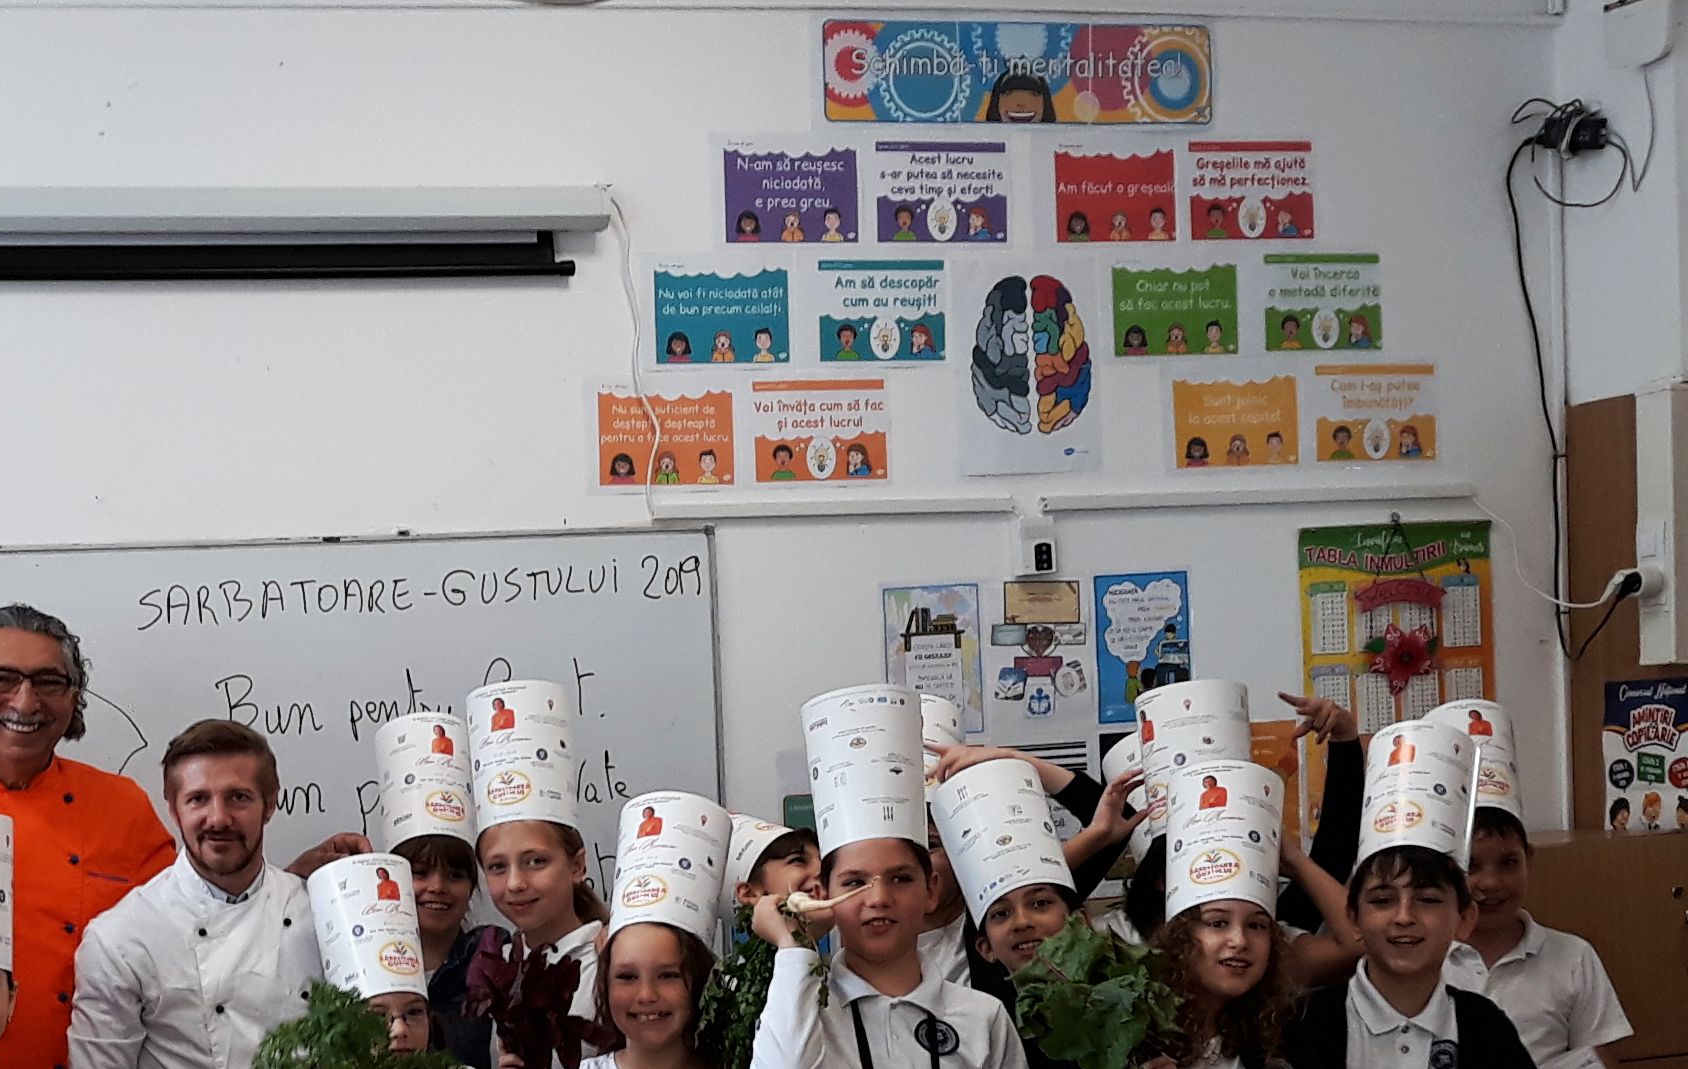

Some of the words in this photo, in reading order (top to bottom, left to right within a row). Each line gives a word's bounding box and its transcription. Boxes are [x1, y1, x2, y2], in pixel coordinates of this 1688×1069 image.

[910, 153, 942, 164] Acest
[946, 153, 974, 164] lucru
[906, 168, 938, 182] putea
[957, 169, 1004, 180] necesite
[920, 183, 943, 197] timp
[767, 197, 796, 211] prea
[834, 275, 856, 289] Am
[658, 287, 675, 299] Nu
[842, 297, 869, 307] cum
[873, 297, 889, 307] au
[662, 303, 676, 315] de
[679, 302, 699, 315] bun
[701, 304, 742, 317] precum
[819, 401, 843, 412] cum
[846, 399, 861, 412] să
[865, 398, 885, 412] fac
[791, 415, 825, 429] acest
[1304, 545, 1359, 569] TABLA
[216, 674, 324, 736] Bun
